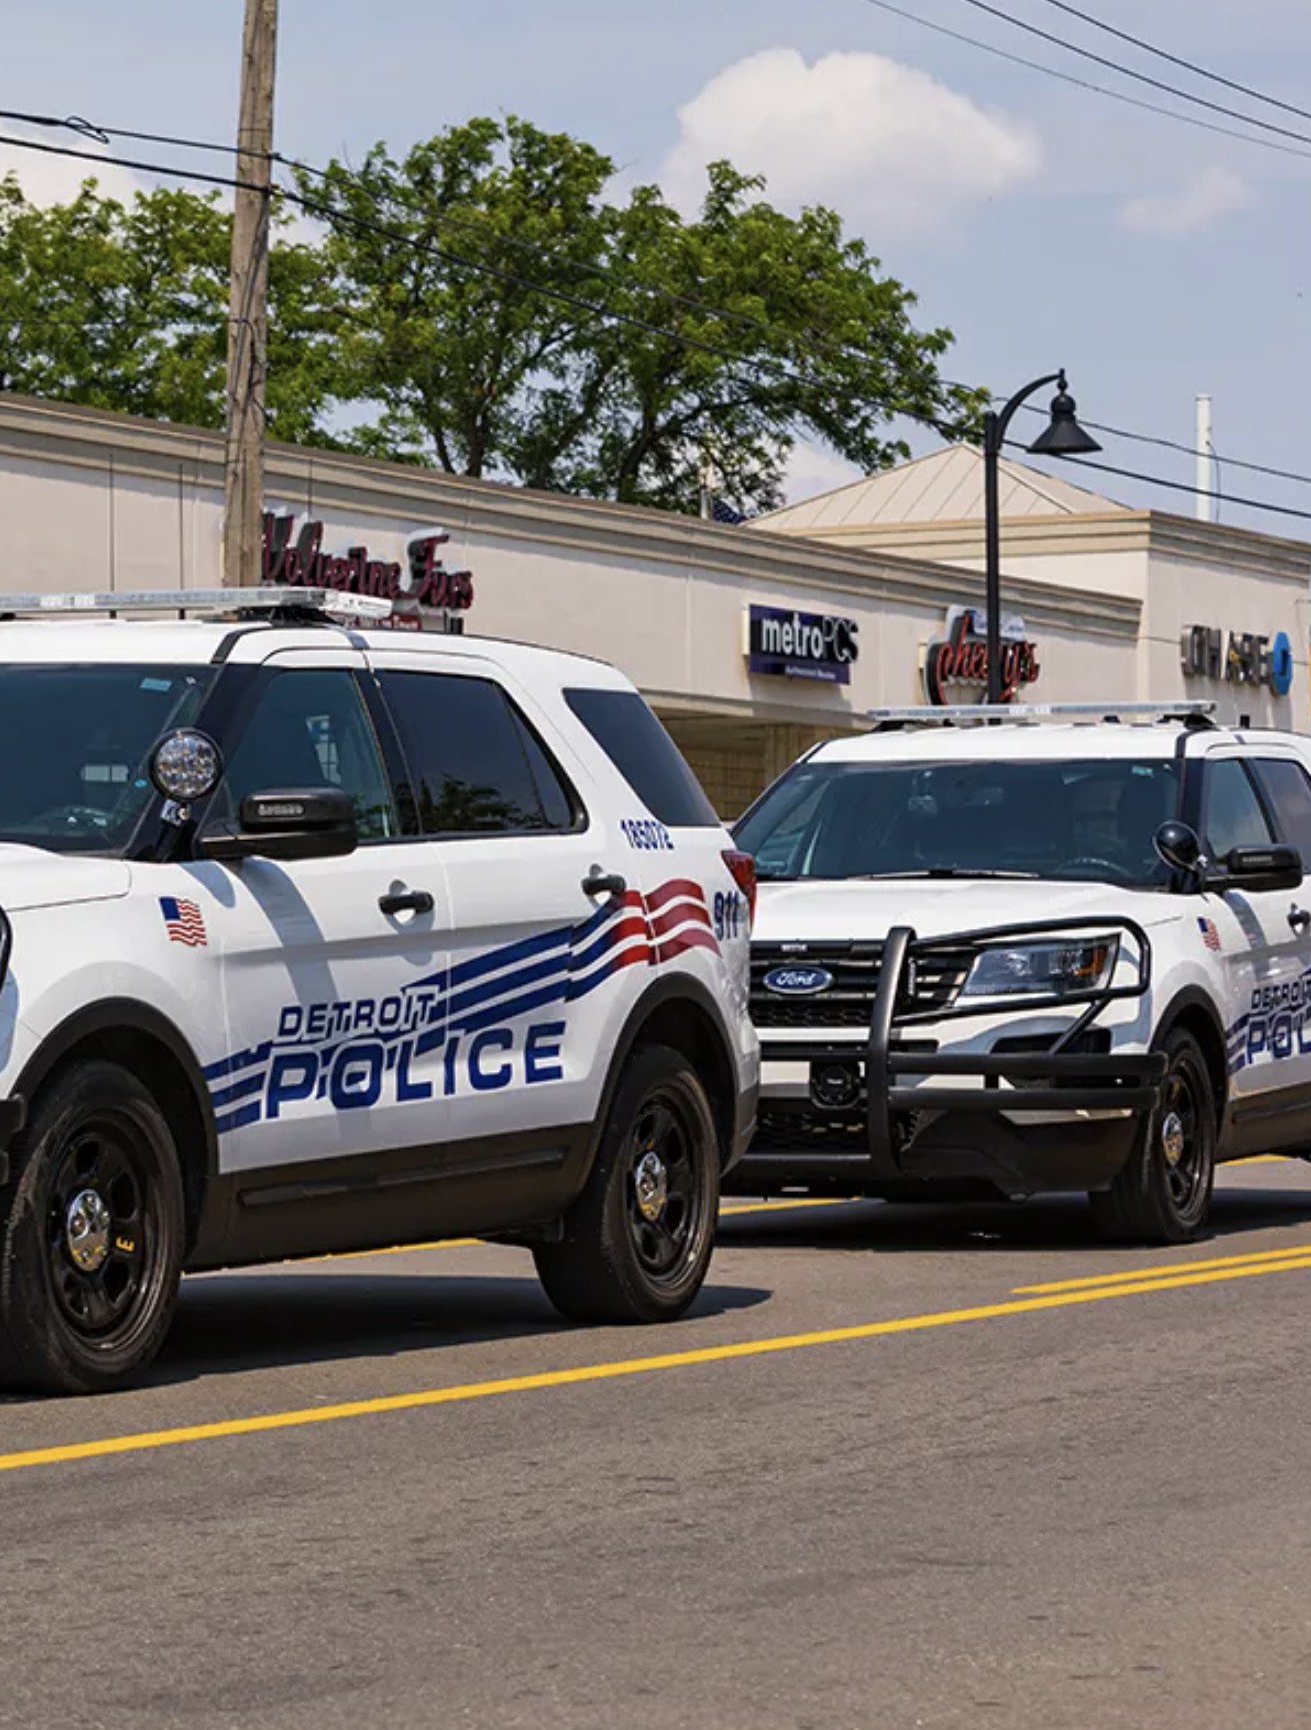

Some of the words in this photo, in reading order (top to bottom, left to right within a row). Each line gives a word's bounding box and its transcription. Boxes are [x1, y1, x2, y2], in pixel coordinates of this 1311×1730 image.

[714, 891, 739, 941] 911
[776, 971, 817, 985] Ford
[278, 993, 435, 1036] DETROIT
[266, 1020, 566, 1119] POLICE
